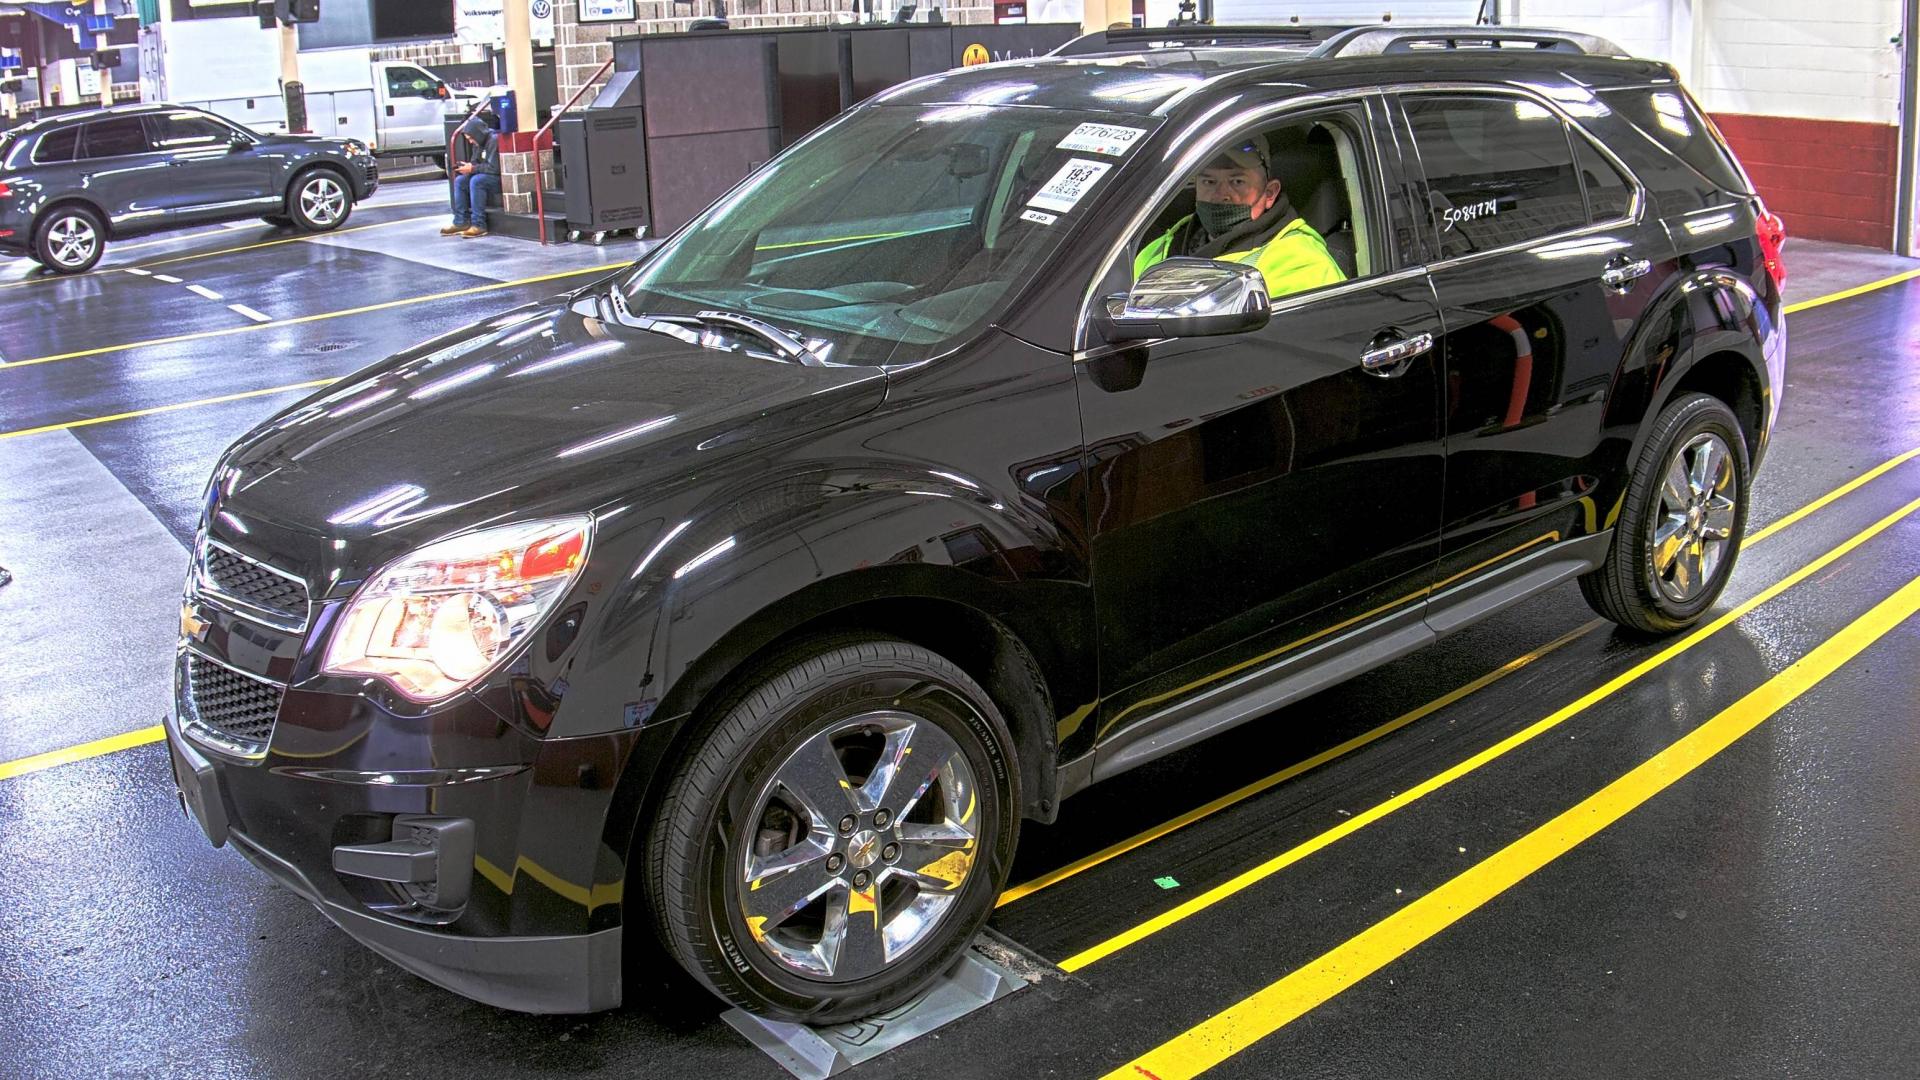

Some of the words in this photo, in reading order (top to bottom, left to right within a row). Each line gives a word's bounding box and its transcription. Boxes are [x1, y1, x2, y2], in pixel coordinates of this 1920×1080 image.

[1074, 125, 1137, 141] 6776723
[1066, 168, 1093, 182] 19:3
[1443, 199, 1497, 232] 5084774
[721, 934, 750, 974] FINESSE
